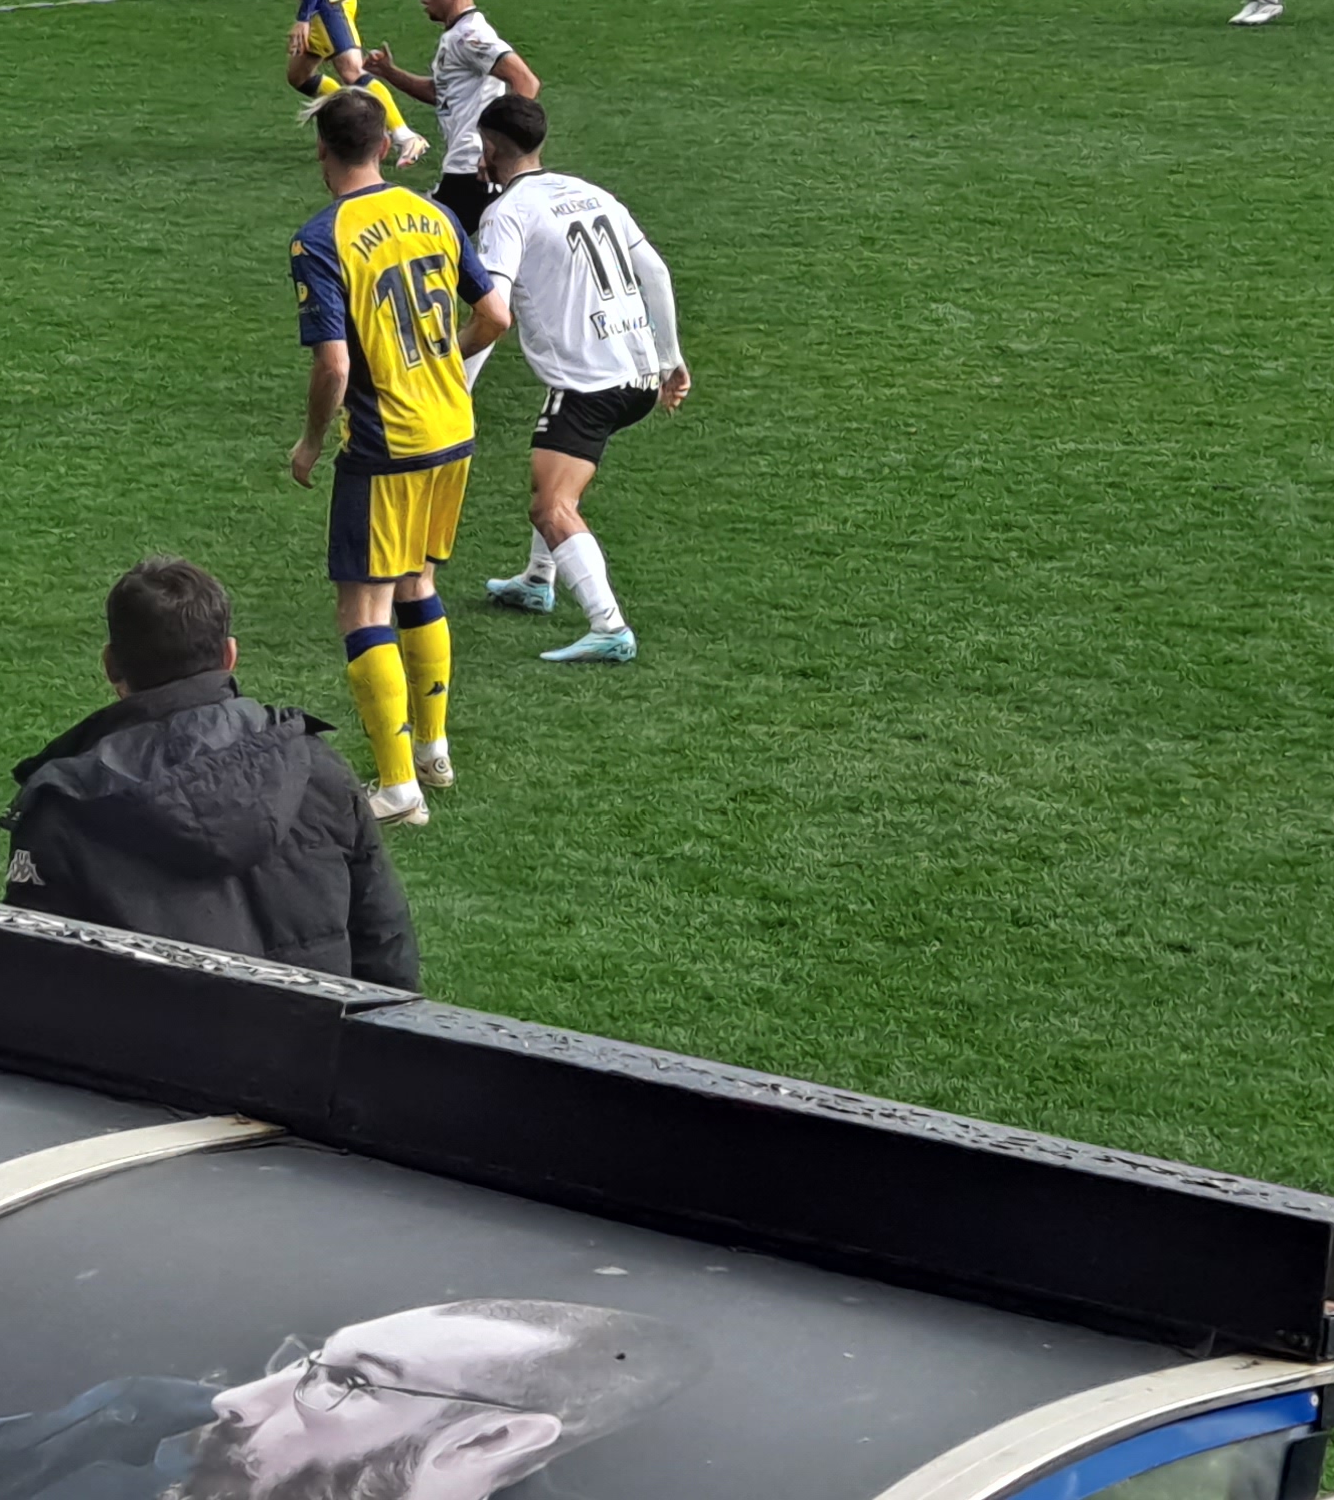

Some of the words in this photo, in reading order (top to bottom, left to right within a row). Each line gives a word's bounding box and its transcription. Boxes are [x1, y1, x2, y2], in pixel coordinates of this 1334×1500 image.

[351, 218, 392, 263] JAVI
[393, 213, 442, 237] LARA
[565, 214, 637, 302] 11
[372, 252, 454, 372] 15
